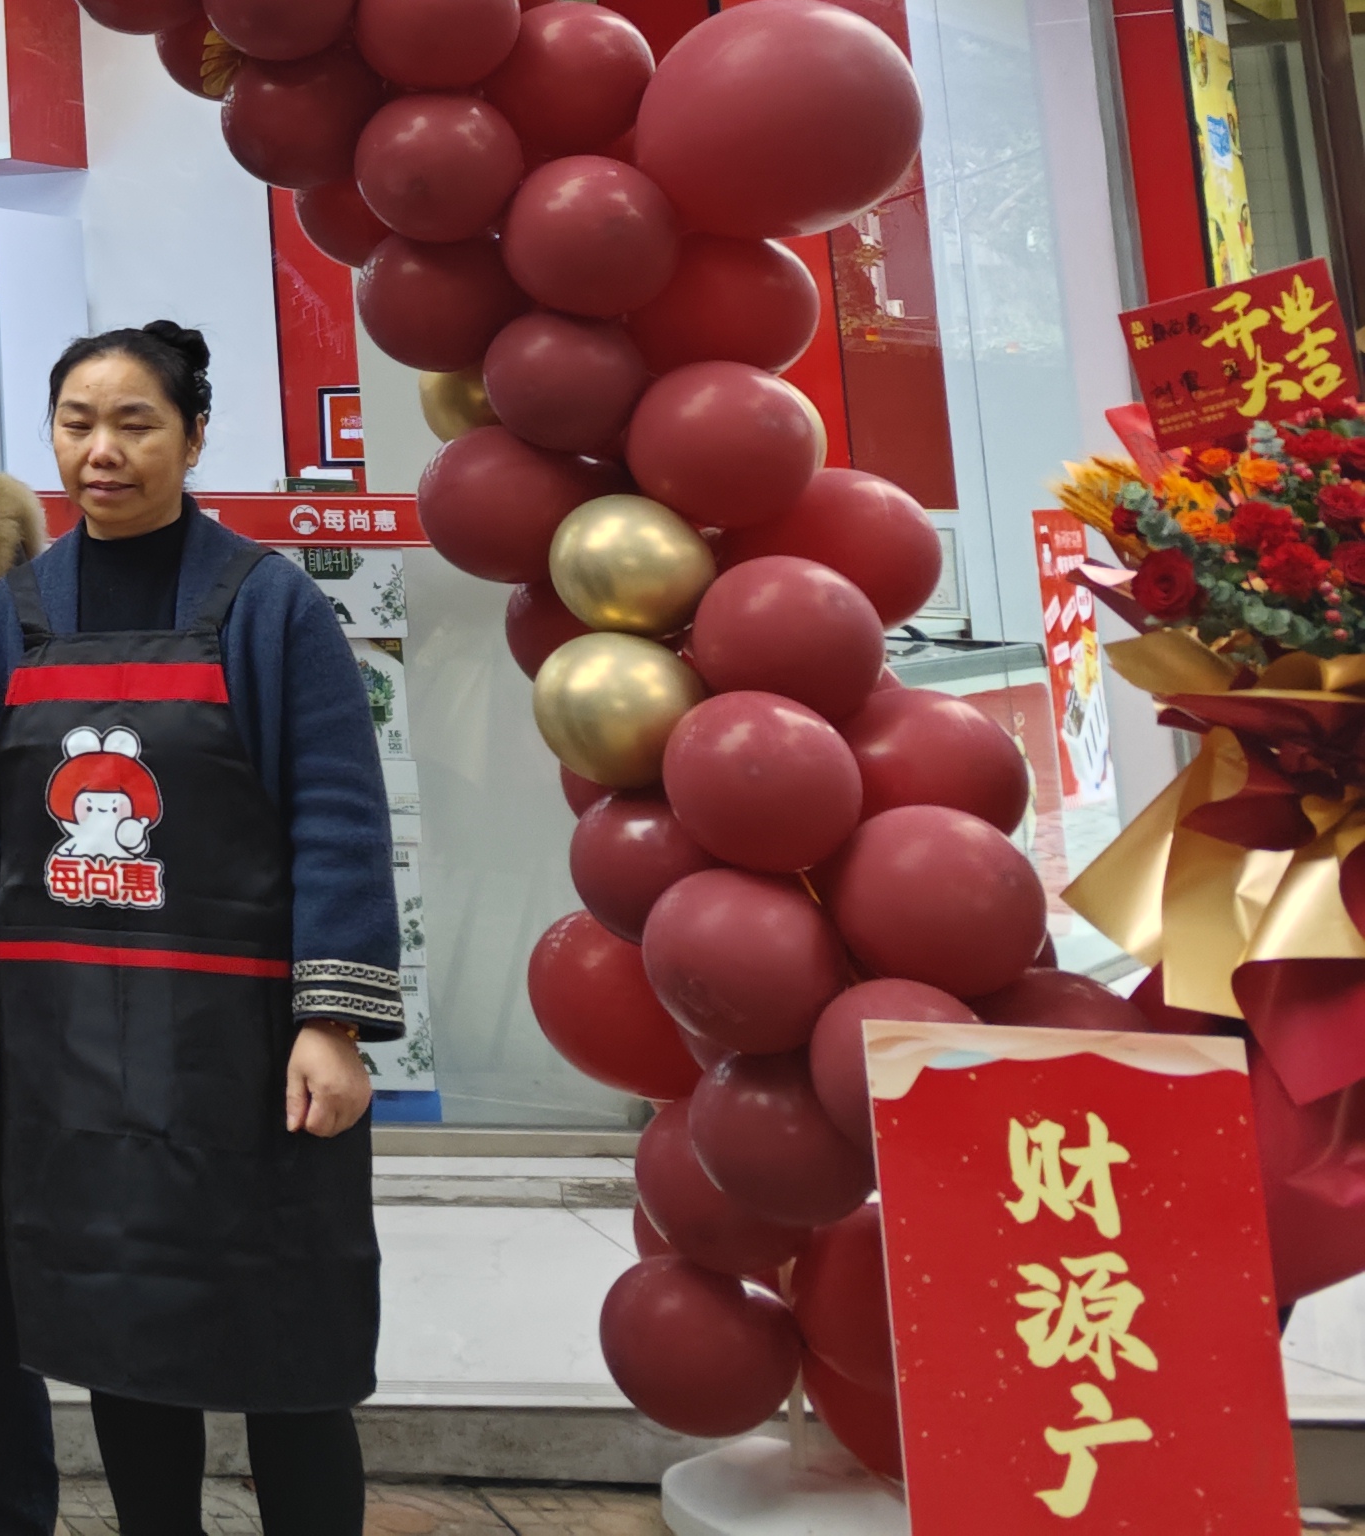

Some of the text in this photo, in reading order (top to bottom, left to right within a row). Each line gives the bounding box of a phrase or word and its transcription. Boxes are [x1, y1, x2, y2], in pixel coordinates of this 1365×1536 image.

[1201, 274, 1334, 360] 开业
[1236, 327, 1347, 417] 大吉
[323, 509, 396, 532] 每尚惠
[50, 857, 158, 905] 每尚惠
[1005, 1112, 1158, 1518] 财源广
